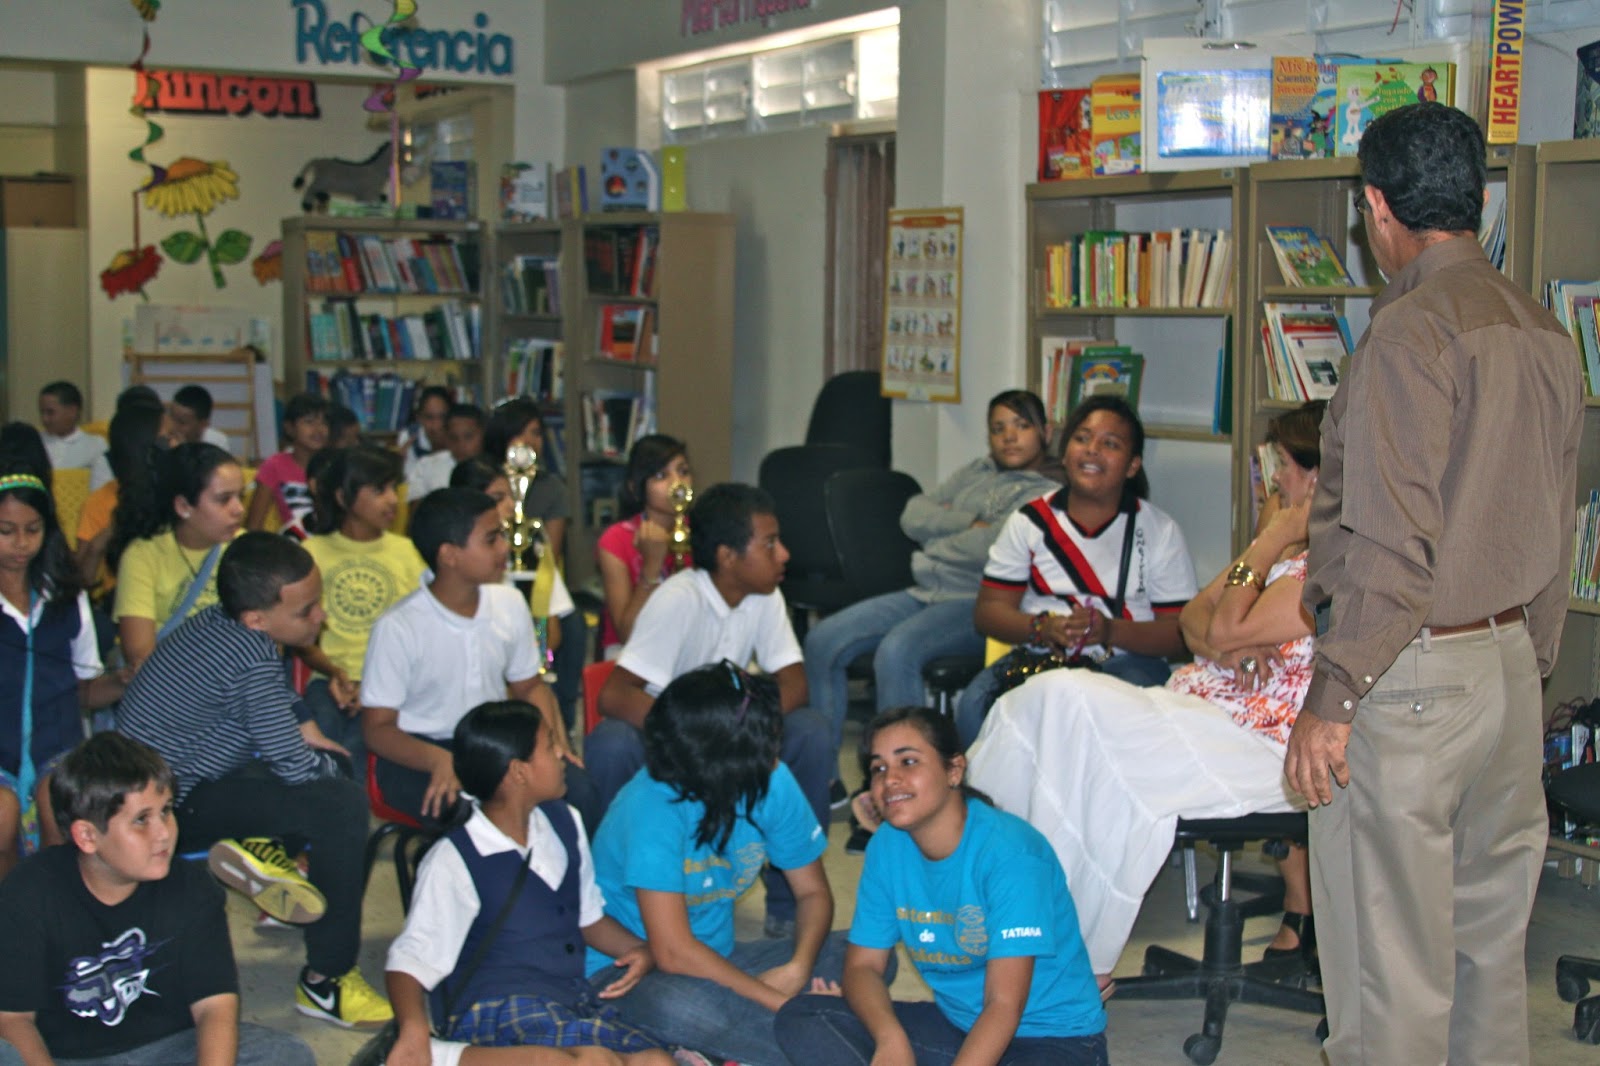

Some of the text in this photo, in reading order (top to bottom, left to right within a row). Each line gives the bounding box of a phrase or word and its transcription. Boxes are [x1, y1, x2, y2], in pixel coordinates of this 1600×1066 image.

[1106, 105, 1130, 121] Los
[919, 929, 935, 943] de
[1001, 927, 1042, 940] TATIANA
